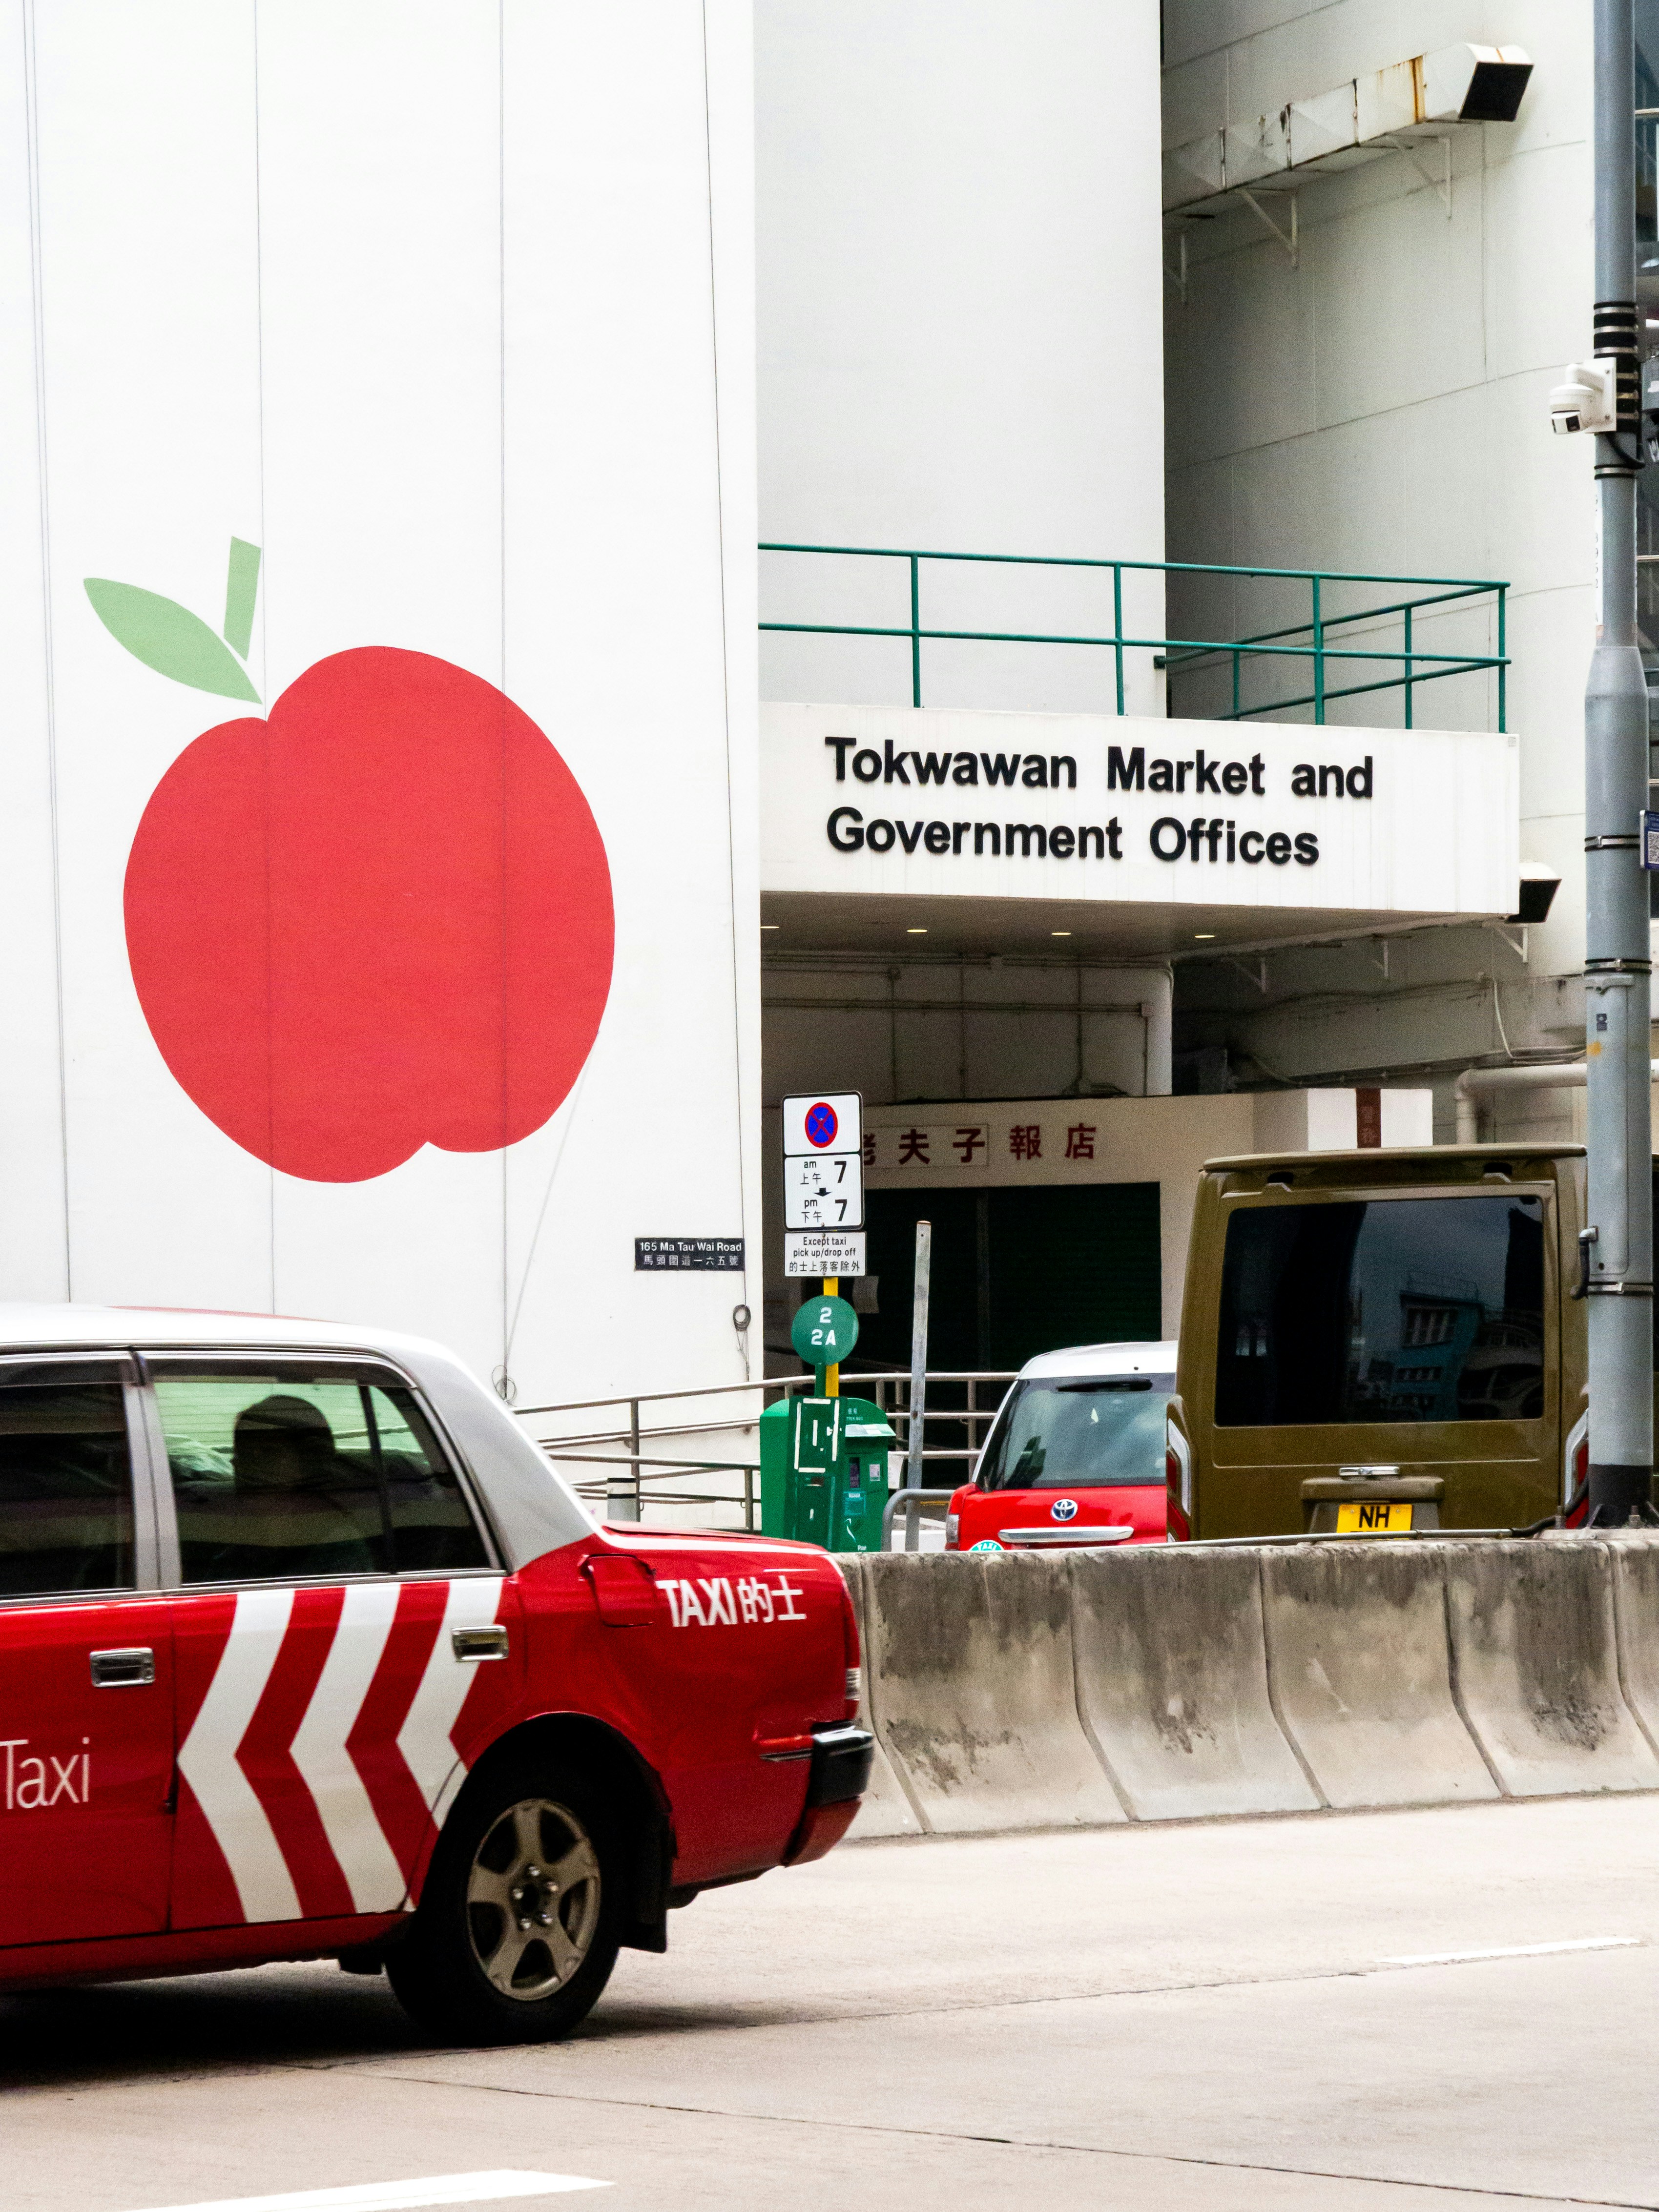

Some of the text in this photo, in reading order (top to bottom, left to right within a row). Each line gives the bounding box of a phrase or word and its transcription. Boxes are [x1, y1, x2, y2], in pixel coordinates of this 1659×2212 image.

[825, 736, 1373, 799] Tokwawan Market and
[827, 806, 1319, 865] Government Offices
[800, 1173, 821, 1185] 上午
[834, 1160, 847, 1183] 7
[800, 1211, 822, 1223] 下午
[804, 1199, 848, 1221] pm 7
[640, 1242, 742, 1252] 165 Ma Tau Wai Road
[803, 1237, 847, 1246] Except taxi
[643, 1254, 739, 1266] 馬頭圍道一六五號
[793, 1247, 856, 1258] pick up/drop off
[789, 1261, 860, 1273] 的士上落客除外
[819, 1307, 832, 1323] 2
[811, 1329, 837, 1346] 2A
[1359, 1506, 1390, 1528] NH
[655, 1578, 738, 1627] TAXI
[0, 1737, 90, 1810] Taxi
